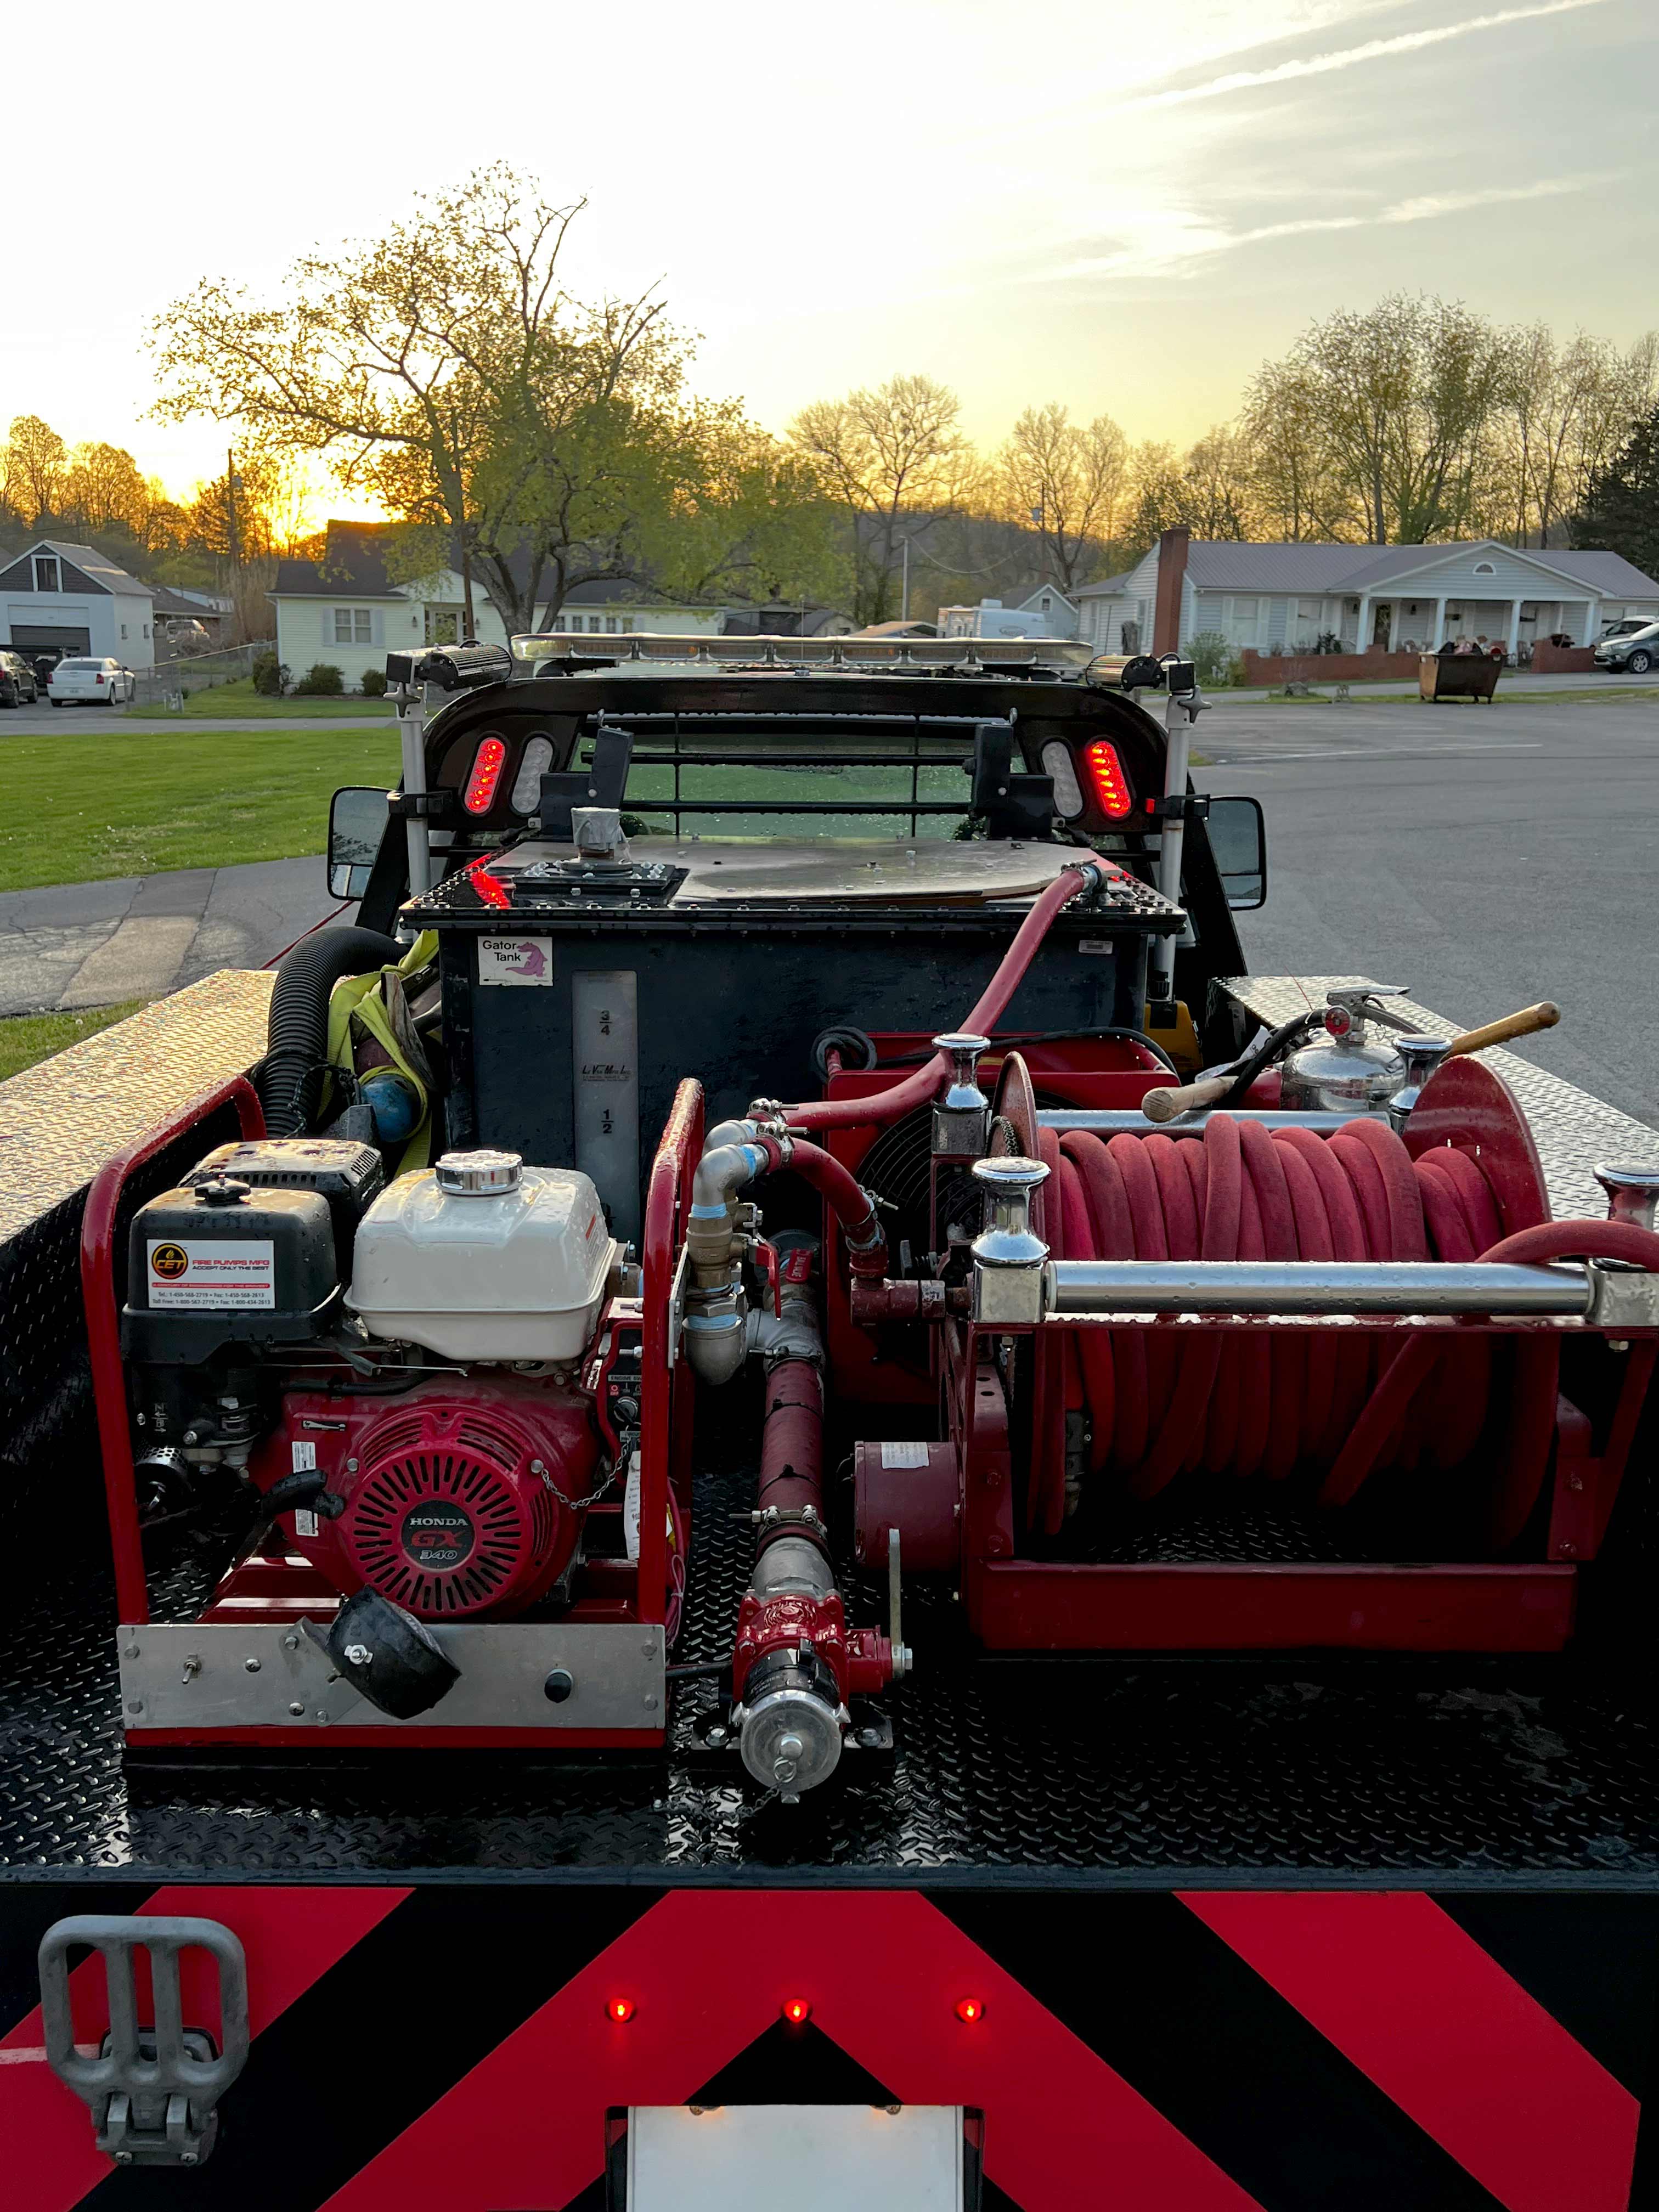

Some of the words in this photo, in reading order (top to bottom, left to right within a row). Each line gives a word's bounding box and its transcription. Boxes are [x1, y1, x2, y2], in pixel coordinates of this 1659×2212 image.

[483, 940, 517, 950] Gator
[494, 952, 521, 961] Tank
[156, 1260, 184, 1269] CET
[410, 1517, 469, 1526] HONDA
[411, 1530, 465, 1548] GX
[420, 1550, 458, 1560] 340
